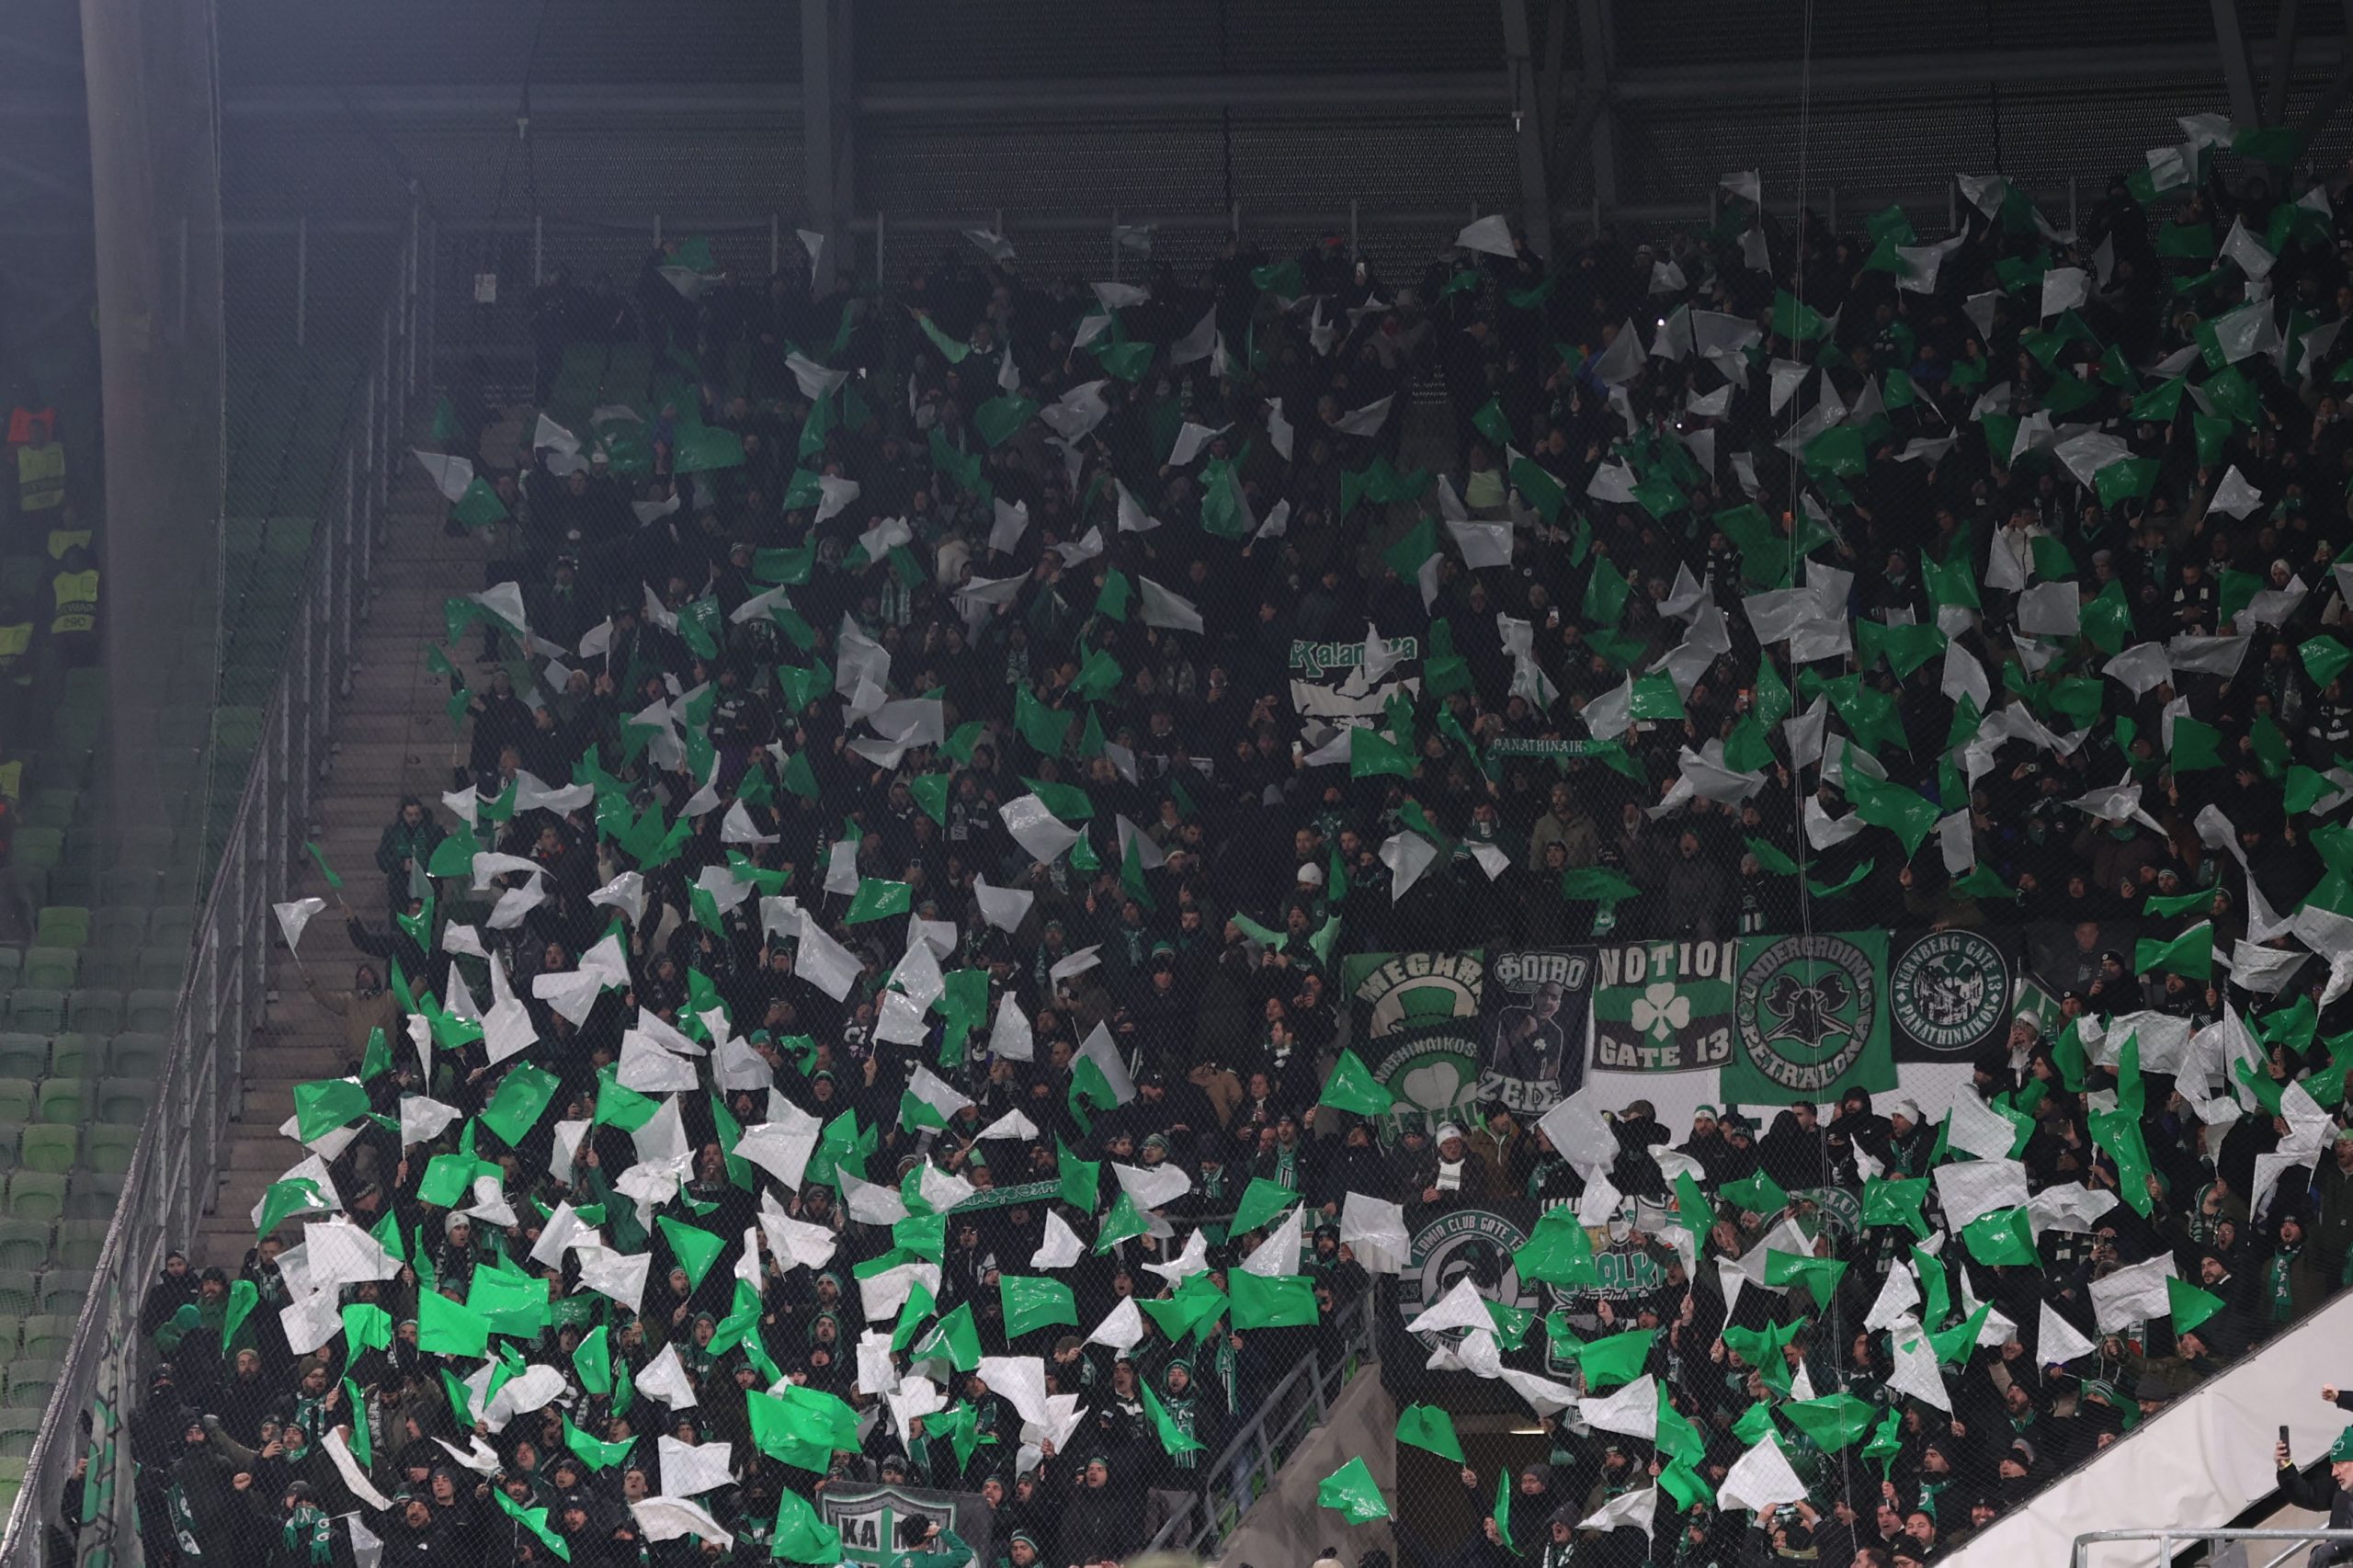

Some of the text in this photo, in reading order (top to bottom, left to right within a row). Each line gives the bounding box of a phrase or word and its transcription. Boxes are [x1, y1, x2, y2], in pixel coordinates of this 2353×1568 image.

[1493, 738, 1588, 753] PANATHINAIK
[1965, 940, 1997, 971] GATE
[1986, 974, 2003, 992] 13
[1897, 1003, 1999, 1046] PANATHINAIKOS
[1373, 1036, 1478, 1085] NATHINAIKOS
[1599, 1028, 1730, 1067] GATE 13
[1447, 1215, 1476, 1233] CLUB
[1480, 1217, 1511, 1240] GATE
